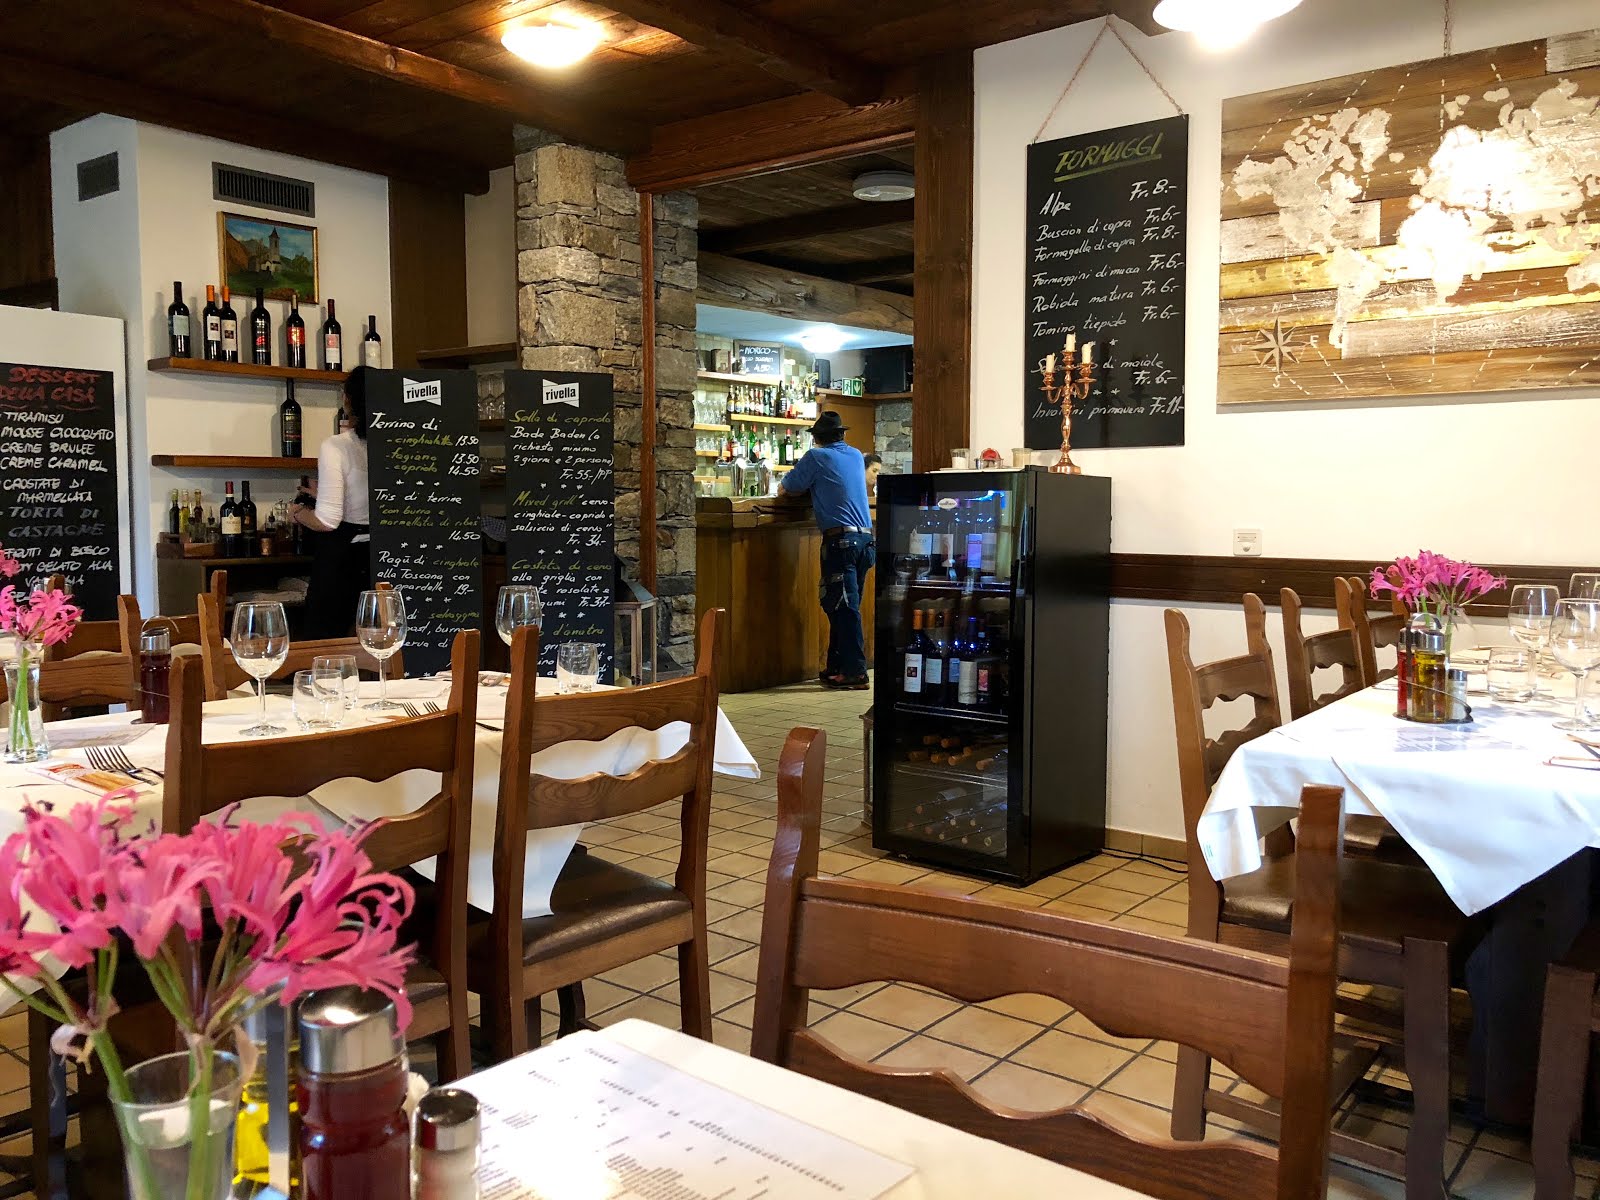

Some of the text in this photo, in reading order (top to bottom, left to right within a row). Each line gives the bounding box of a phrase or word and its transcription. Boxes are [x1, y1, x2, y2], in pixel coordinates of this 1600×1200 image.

[1055, 132, 1164, 173] FORMAGGI
[1040, 191, 1071, 217] Alpe
[1129, 181, 1149, 201] Fr.
[1036, 223, 1082, 242] Buscion
[1087, 218, 1100, 234] di
[1103, 219, 1132, 235] capra
[1094, 238, 1107, 251] di
[1107, 238, 1136, 253] capra
[1032, 269, 1093, 287] Formaggini
[1095, 264, 1111, 278] di
[1032, 292, 1079, 313] Robiola
[1088, 285, 1134, 304] matura
[1141, 279, 1156, 296] Fr.
[1033, 321, 1076, 338] Tomino
[1083, 312, 1127, 333] tiepido
[1103, 355, 1117, 369] di
[1120, 353, 1164, 369] maiale
[1133, 370, 1151, 385] Fr.
[1272, 374, 1281, 388] S
[406, 385, 438, 399] rivella
[545, 387, 576, 401] rivella
[3, 411, 64, 424] TIRAMISU
[546, 412, 560, 423] di
[1088, 404, 1145, 420] primavera
[422, 418, 442, 431] di
[550, 427, 586, 439] Baden
[455, 435, 479, 446] 13.50
[512, 441, 596, 452] richiesta minimo
[0, 441, 96, 455] CREME BRULEE
[0, 456, 108, 472] CREME CARAMEL
[451, 453, 479, 465] 13.50
[448, 465, 479, 476] 14.50
[560, 468, 573, 480] Fr.
[69, 479, 85, 489] DI
[16, 491, 93, 504] MARMELLATA
[374, 488, 462, 505] Tris di terrine
[512, 491, 577, 510] Mixed grill
[8, 506, 100, 519] TORTA DI
[403, 505, 431, 515] burro
[380, 516, 433, 527] marmellata
[439, 518, 450, 527] di
[561, 523, 571, 532] di
[8, 523, 105, 538] CASTAGNE
[566, 533, 580, 545] Fr.
[49, 547, 62, 558] DI
[70, 546, 110, 557] BOSCO
[36, 560, 82, 572] GELATO
[87, 560, 113, 571] ALLA
[413, 554, 429, 566] di
[512, 558, 560, 570] Costata
[569, 560, 581, 570] di
[377, 568, 397, 579] alla
[401, 568, 443, 580] Toscana
[512, 572, 532, 581] alla
[541, 573, 576, 585] griglia
[556, 584, 600, 594] rosolate
[407, 608, 419, 620] di
[437, 638, 451, 648] di
